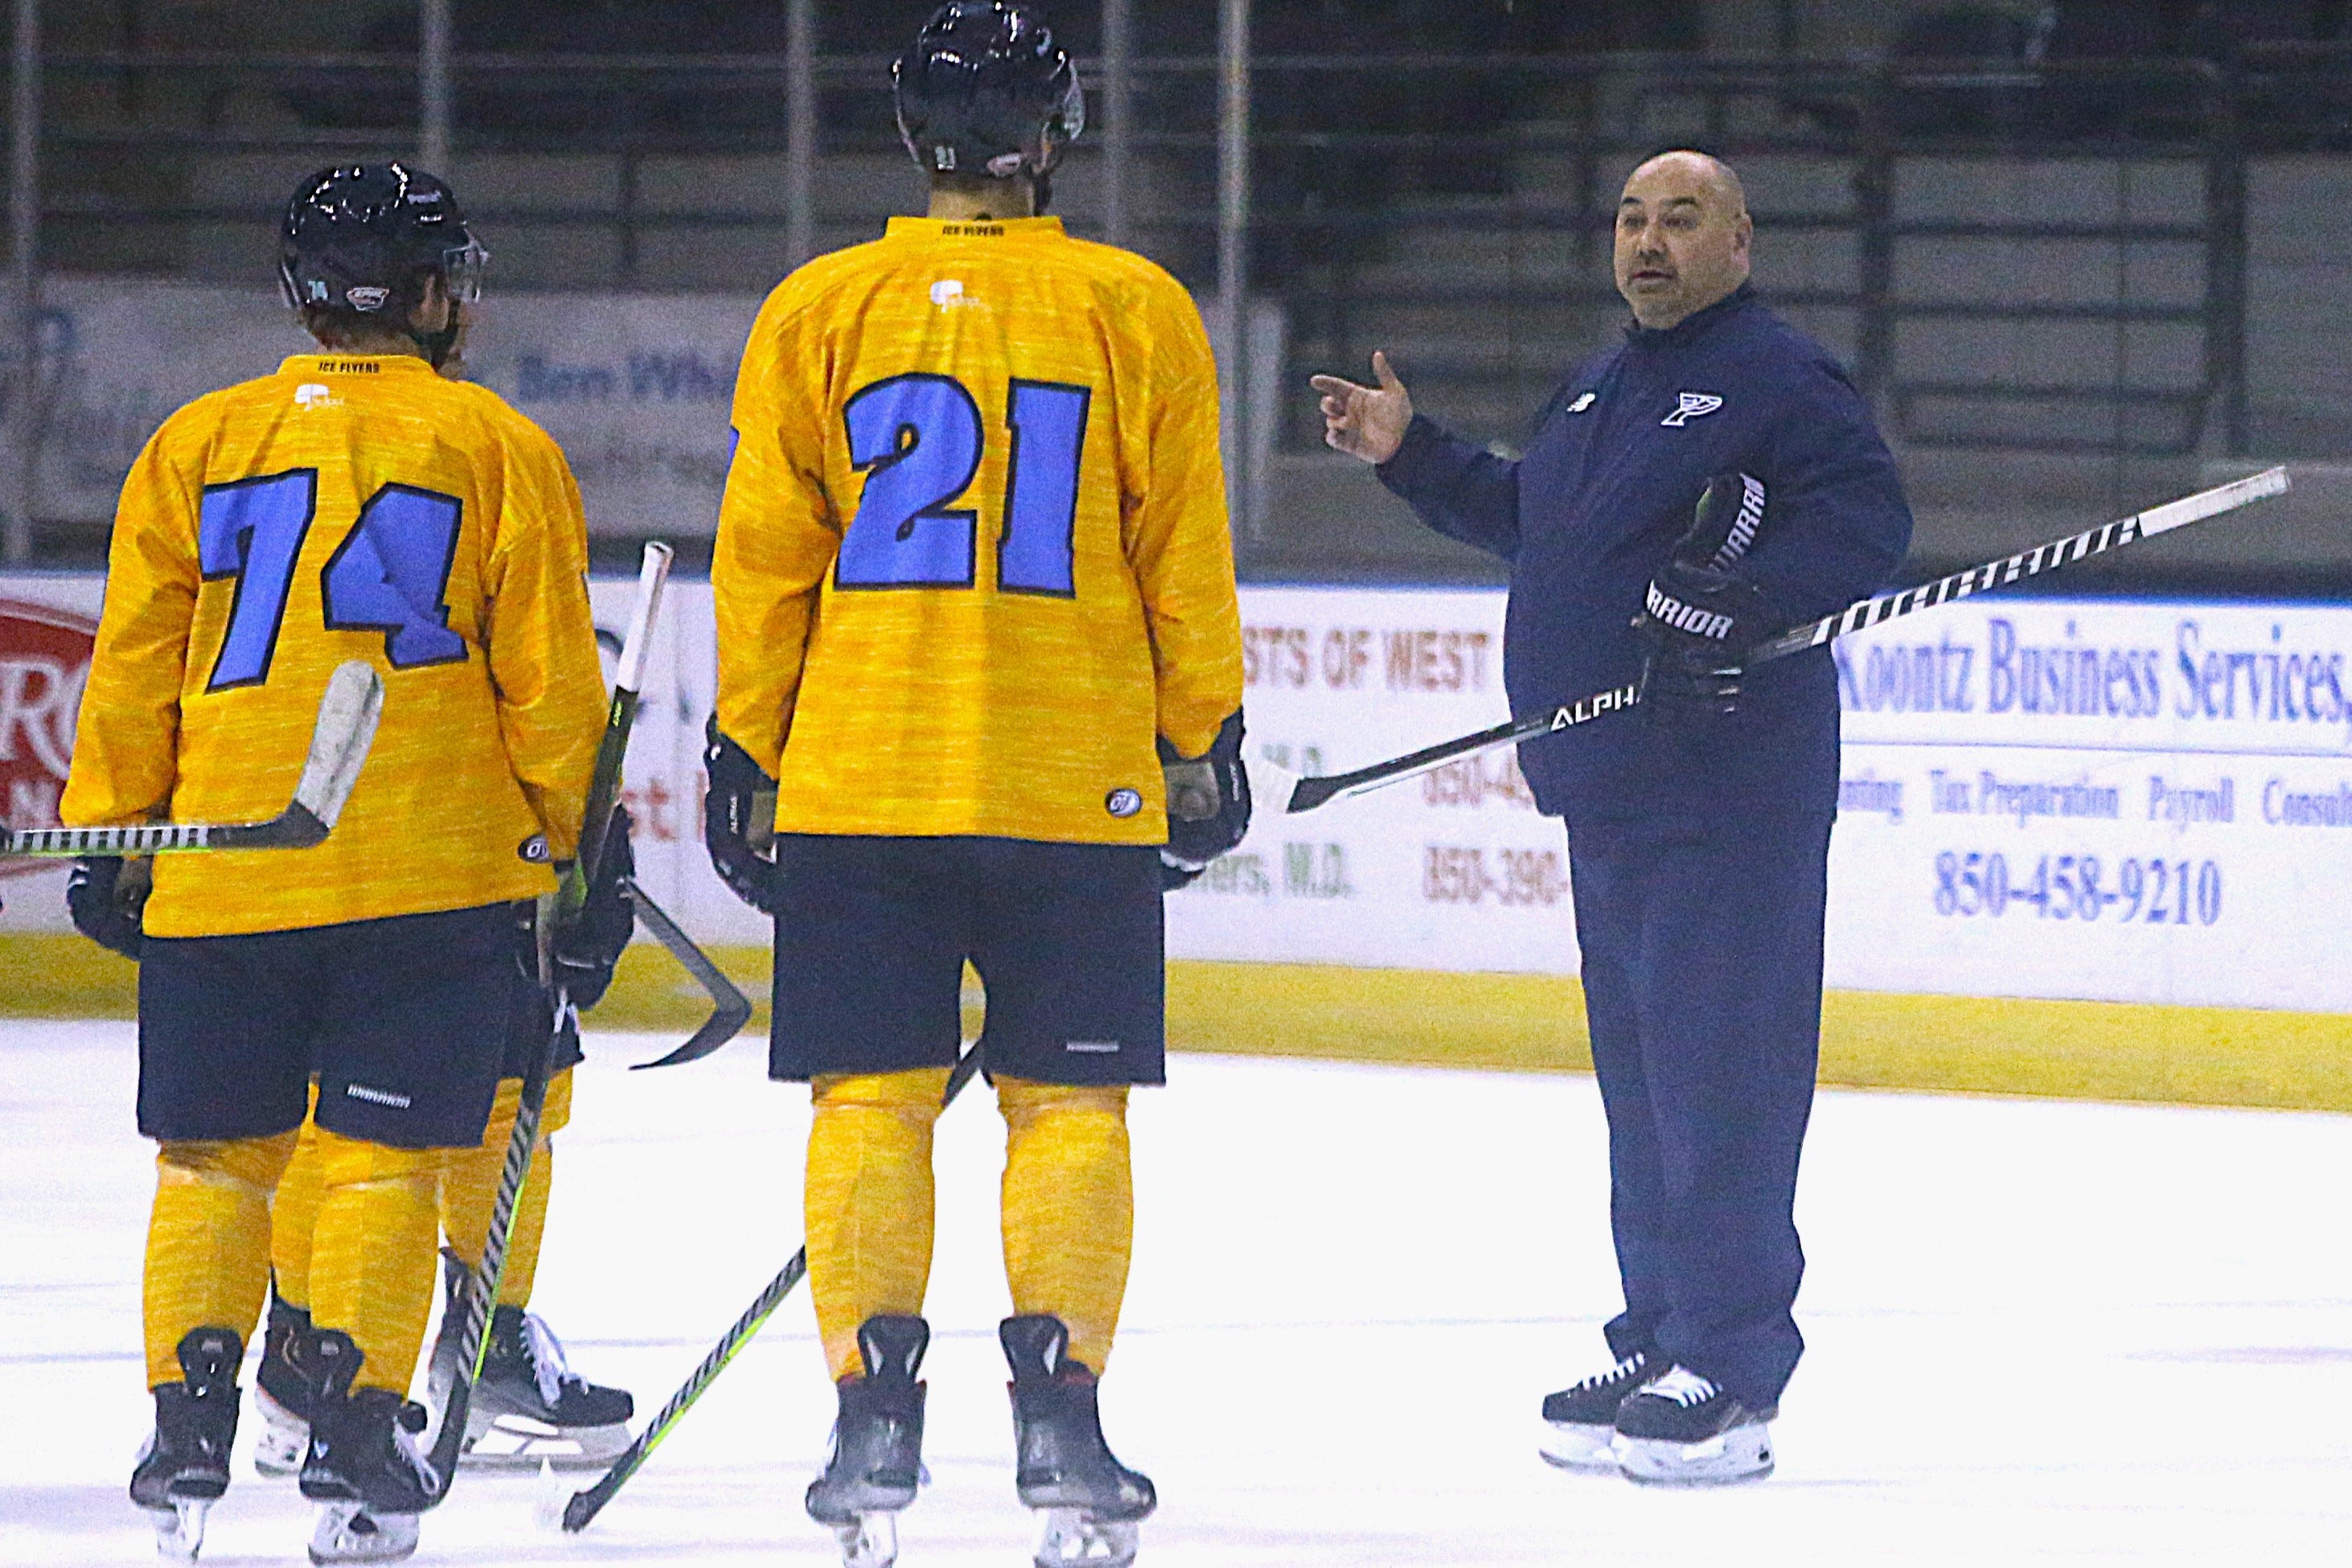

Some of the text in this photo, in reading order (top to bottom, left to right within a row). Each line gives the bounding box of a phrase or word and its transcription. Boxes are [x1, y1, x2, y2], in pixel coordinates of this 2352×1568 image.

[834, 371, 1092, 600] 21
[197, 467, 470, 696] 74
[1321, 627, 1370, 689] OF
[1382, 629, 1491, 692] WEST
[1988, 618, 2163, 717] Business
[1978, 770, 2120, 829] Preparation
[2149, 775, 2235, 831] Payroll
[1934, 849, 2223, 926] 850-458-9210
